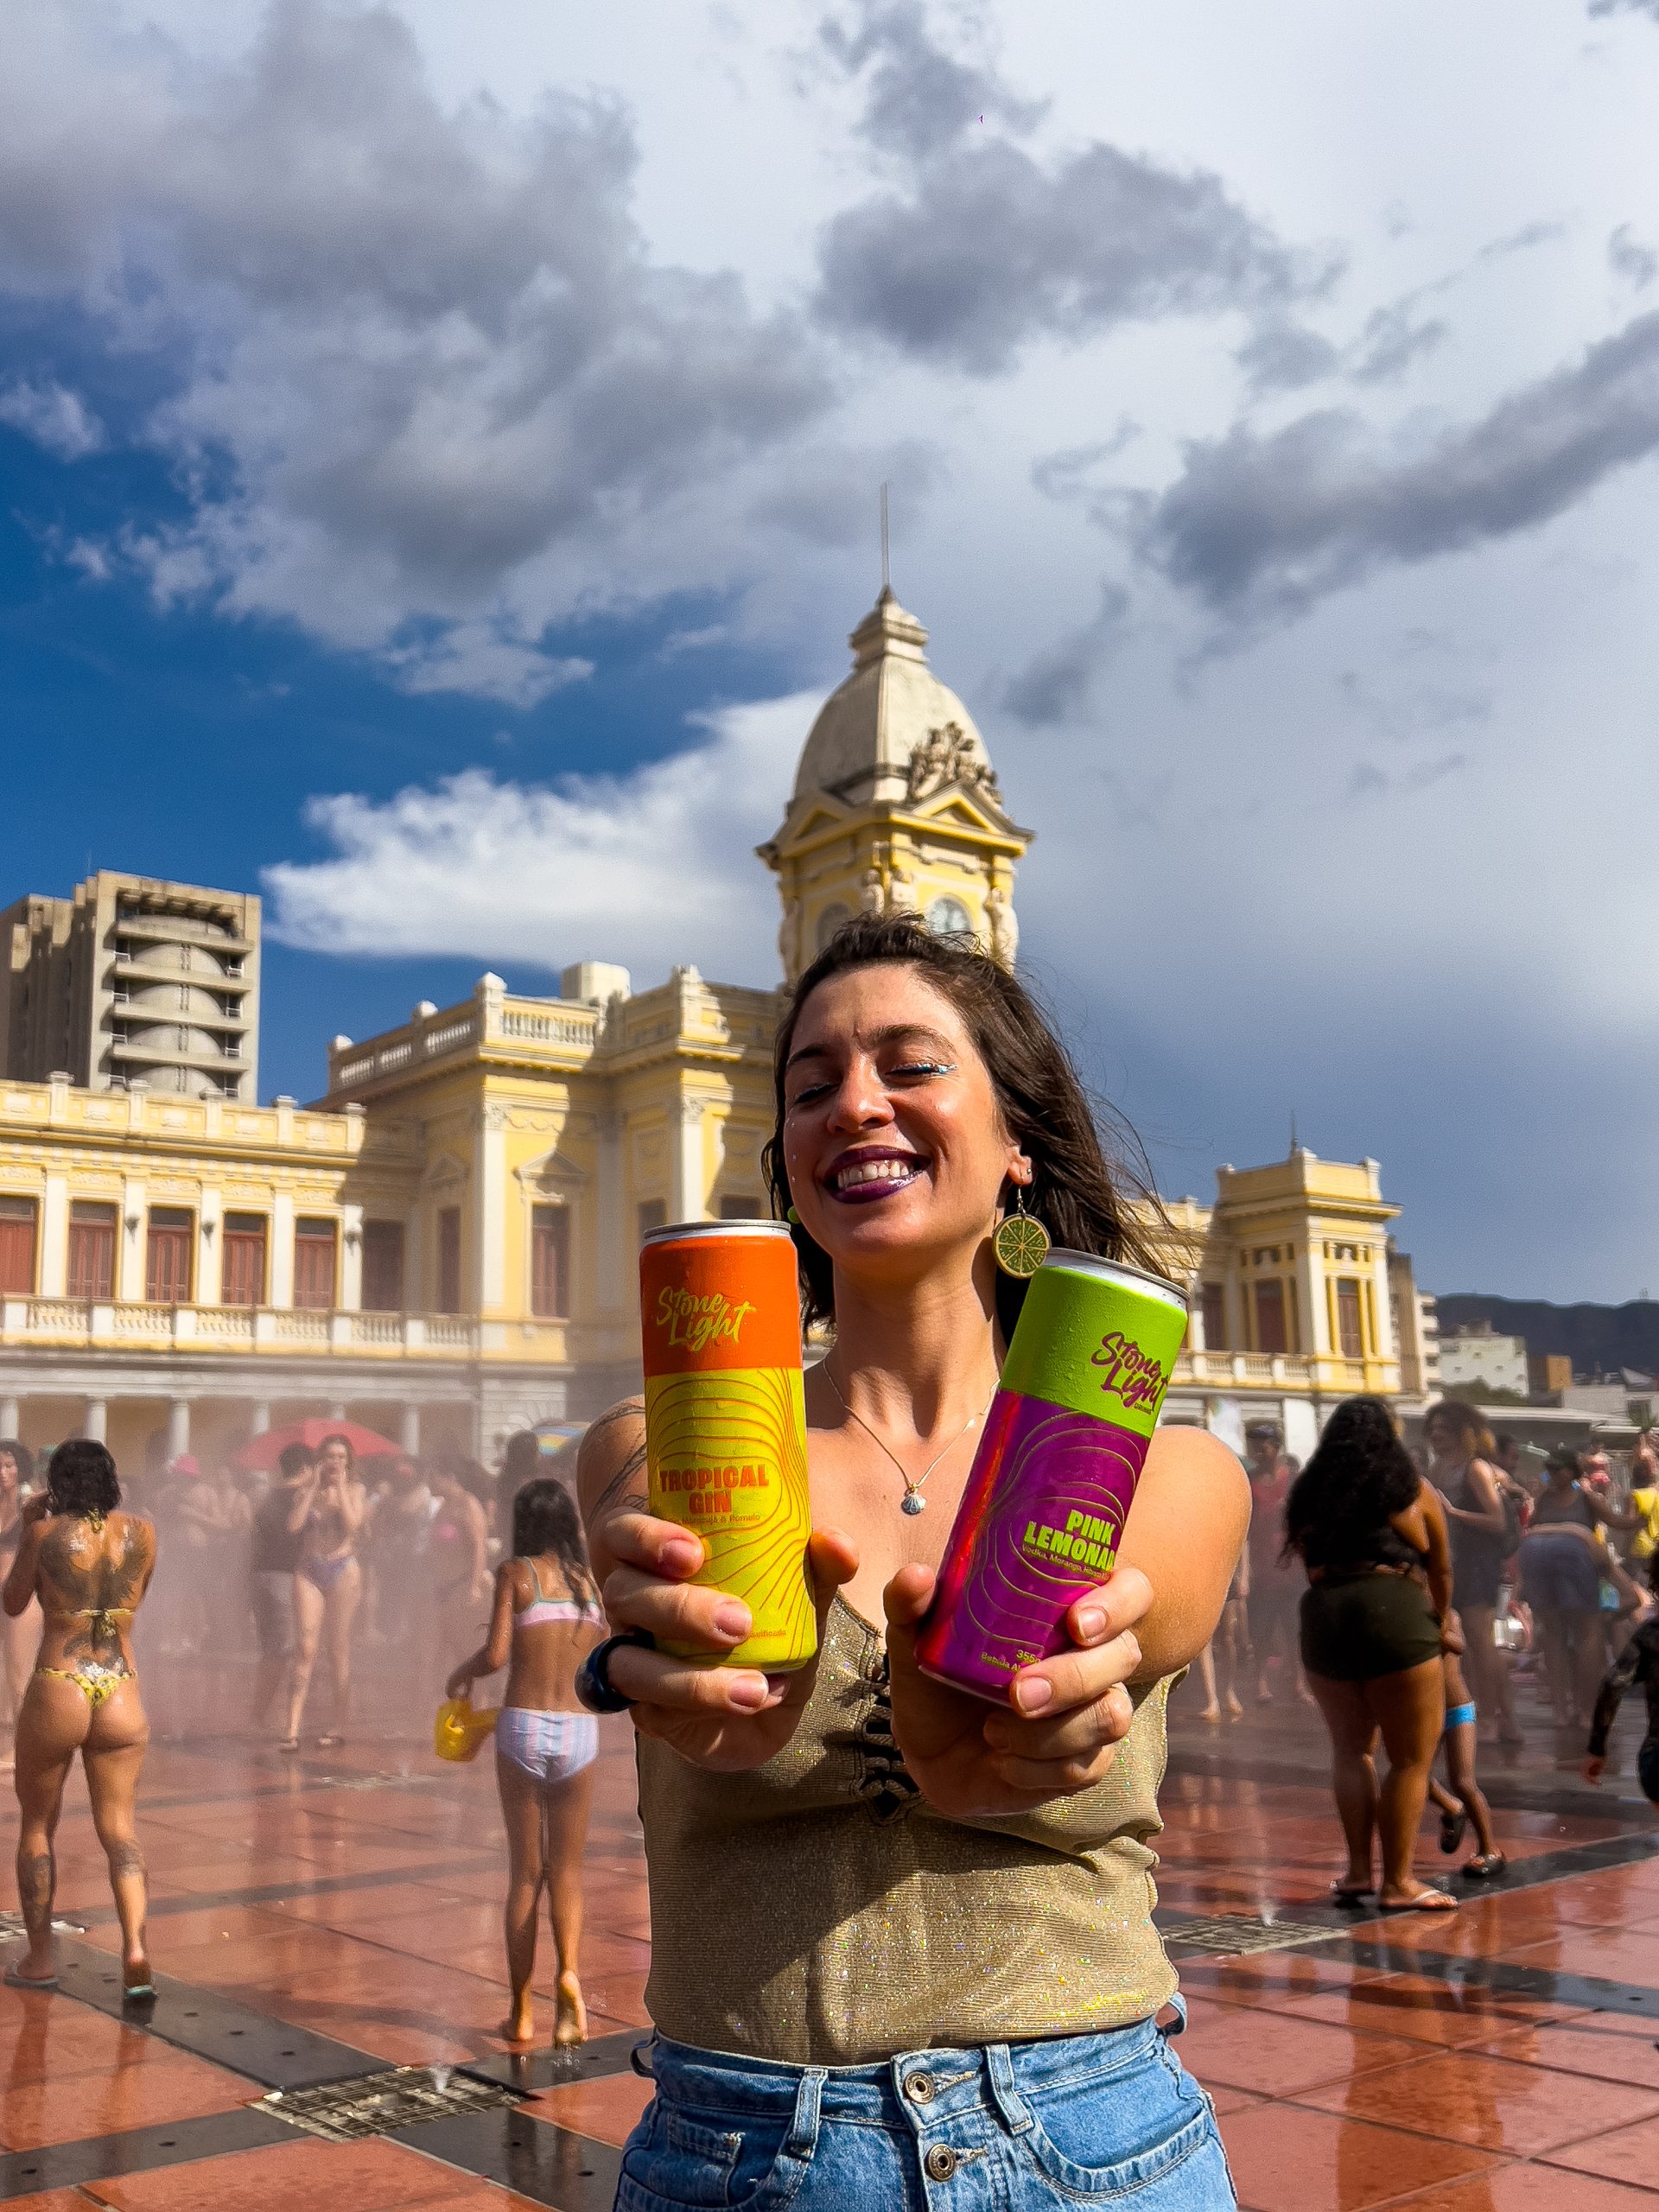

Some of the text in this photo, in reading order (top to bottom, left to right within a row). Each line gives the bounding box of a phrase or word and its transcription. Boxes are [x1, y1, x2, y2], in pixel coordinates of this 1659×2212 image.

[657, 1286, 724, 1325] Stone
[669, 1300, 757, 1351] Light
[1090, 1332, 1160, 1378] Stone
[1100, 1357, 1169, 1412] Light
[659, 1464, 769, 1492] TROPICAL
[689, 1490, 732, 1514] GIN
[1065, 1510, 1116, 1545] PINK
